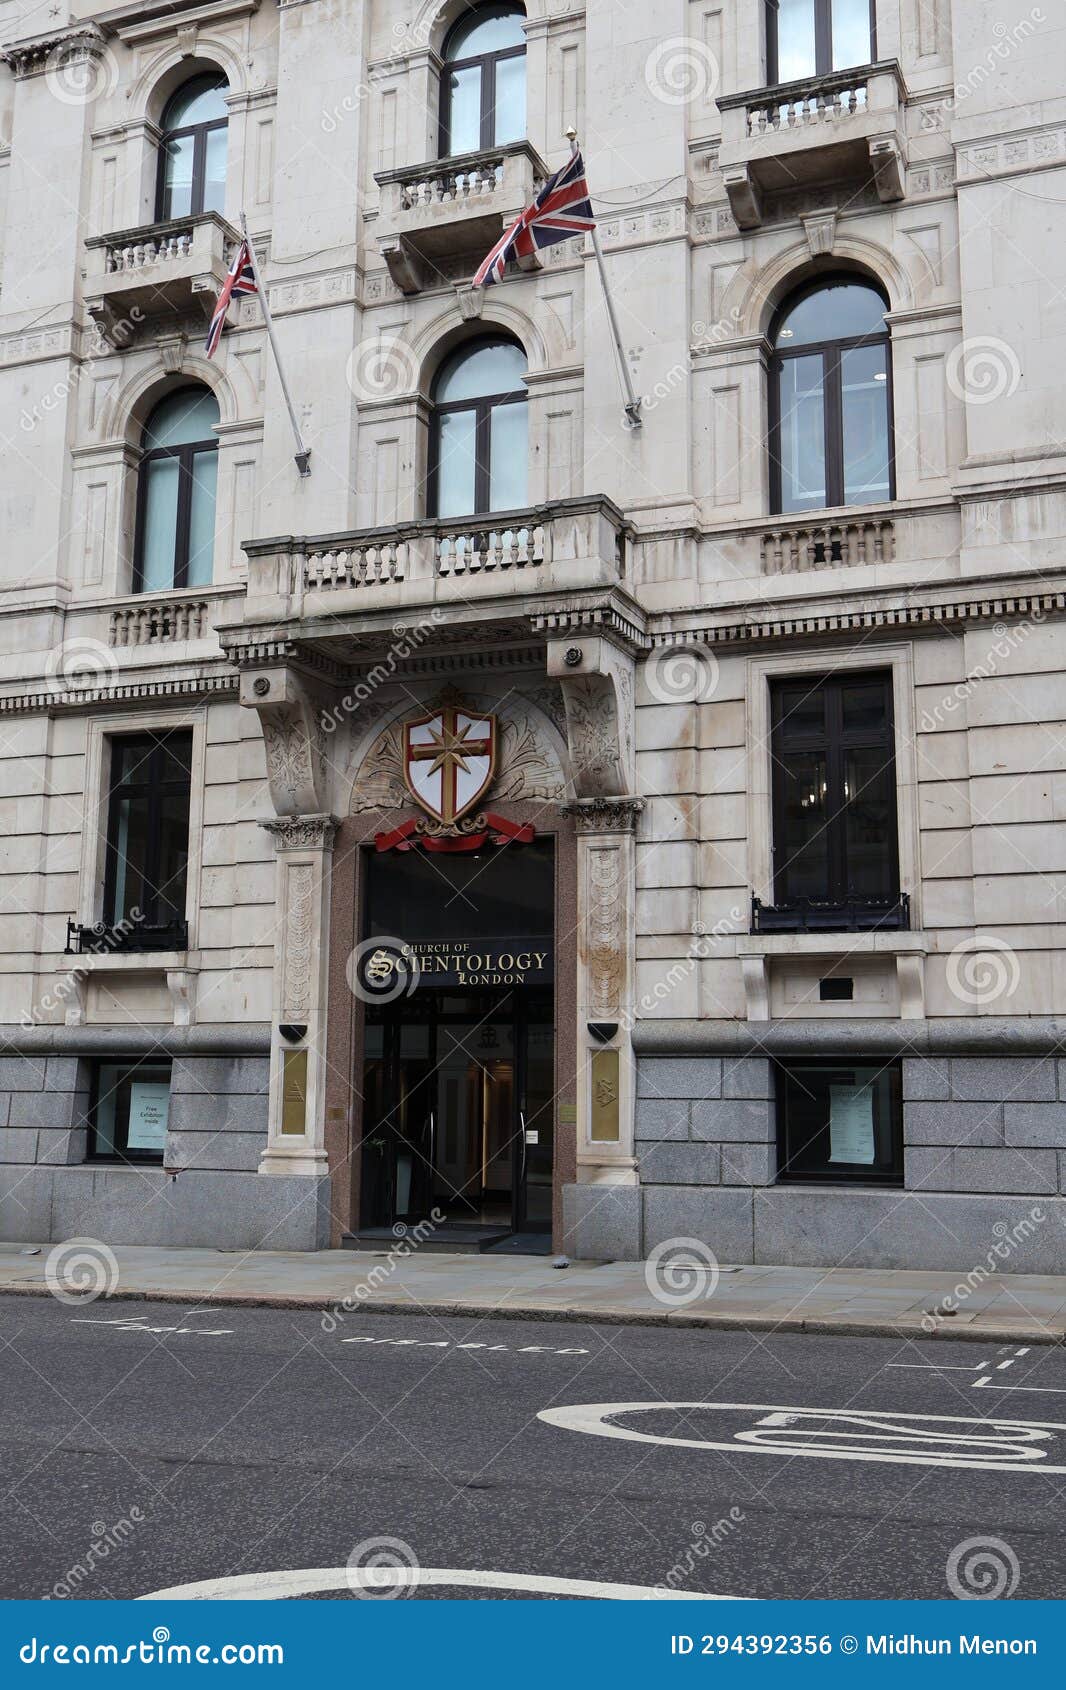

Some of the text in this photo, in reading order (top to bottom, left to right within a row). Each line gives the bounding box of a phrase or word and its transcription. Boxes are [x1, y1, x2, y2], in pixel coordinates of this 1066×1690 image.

[401, 943, 470, 956] CHURCH OF
[368, 949, 548, 979] SCIENTOLOGY
[458, 972, 526, 985] LONDON
[340, 1336, 590, 1354] DISABLED
